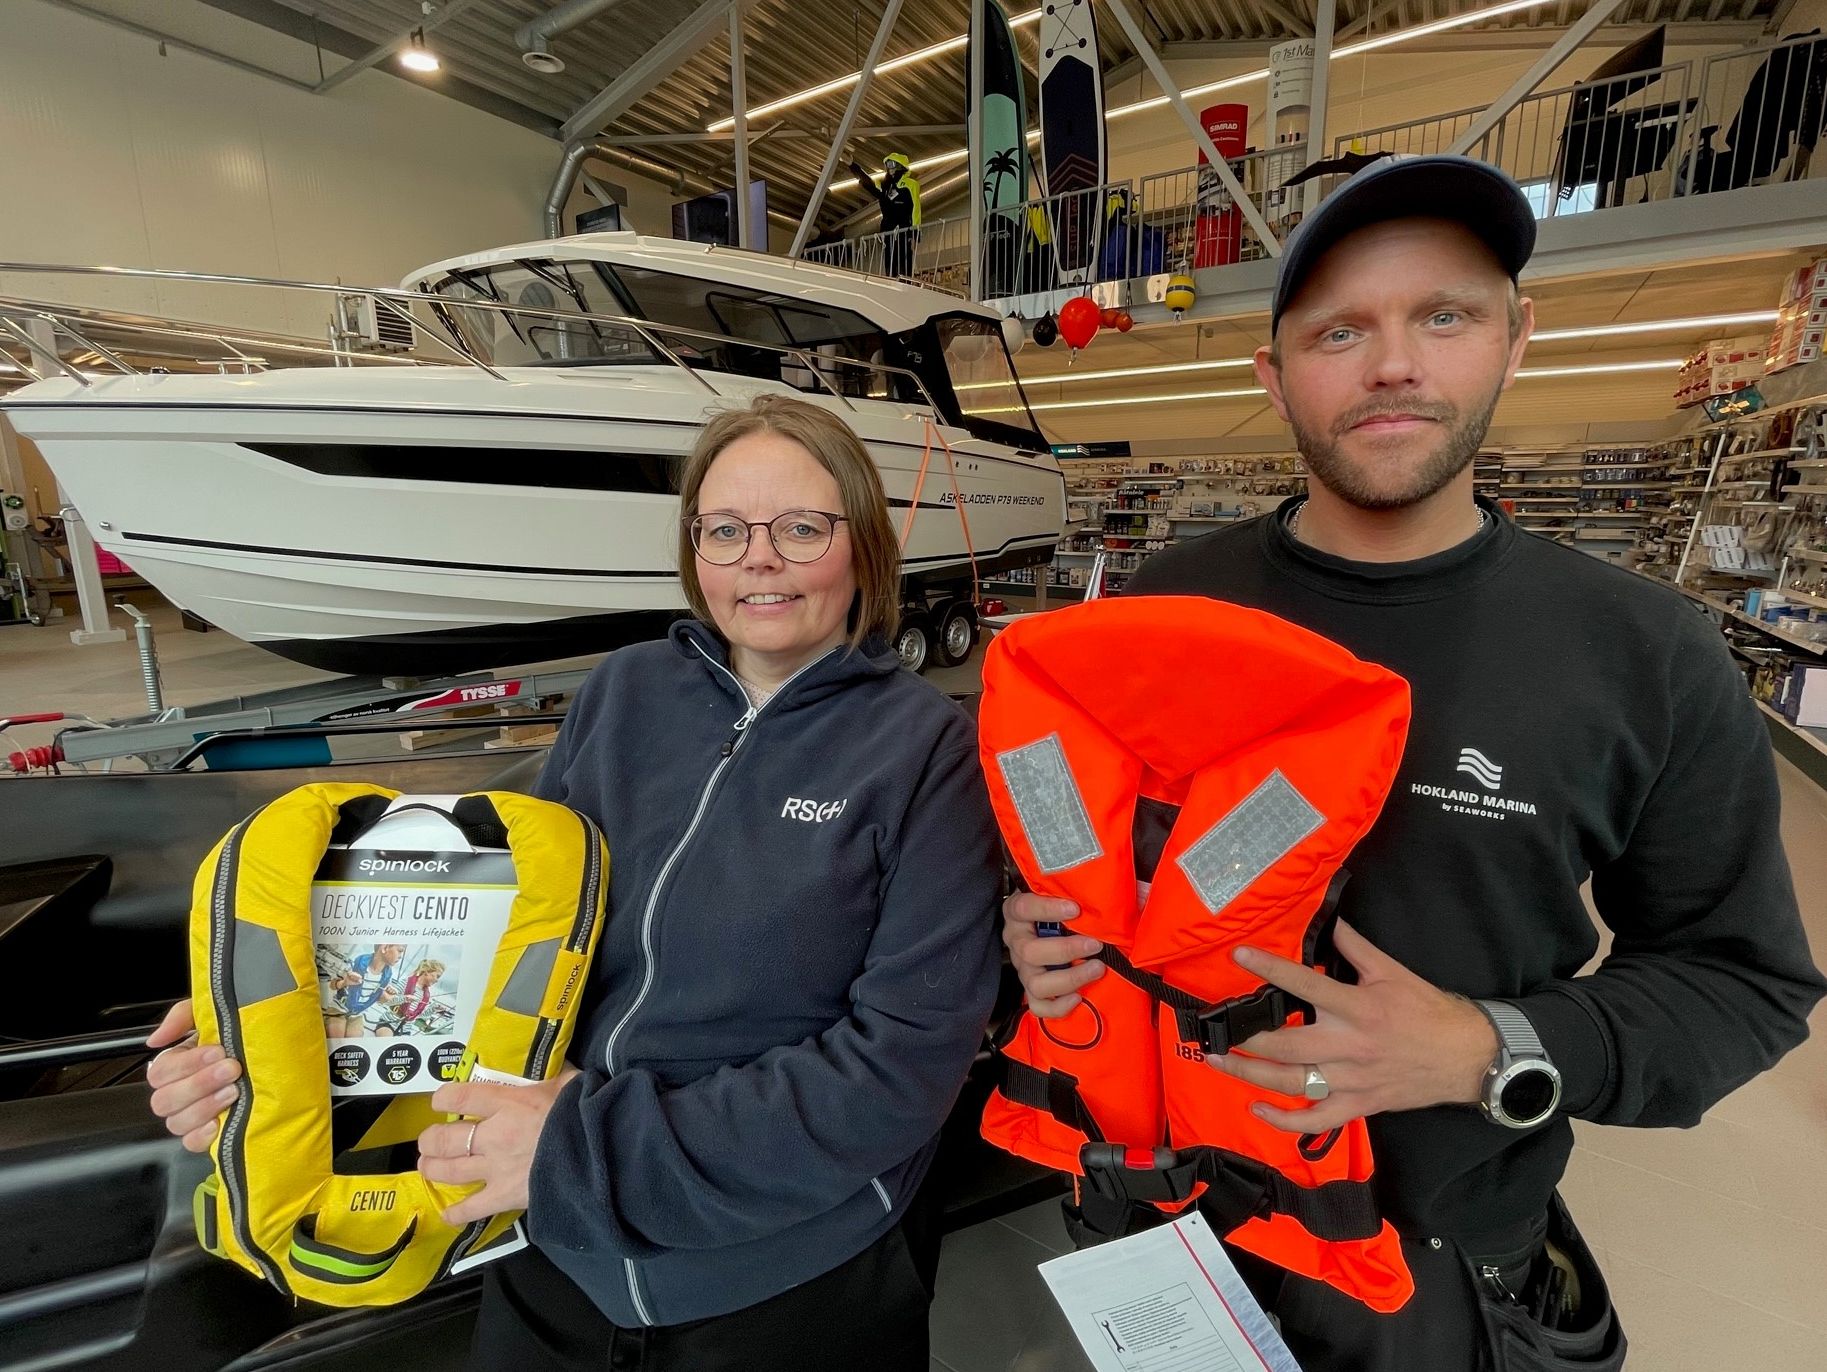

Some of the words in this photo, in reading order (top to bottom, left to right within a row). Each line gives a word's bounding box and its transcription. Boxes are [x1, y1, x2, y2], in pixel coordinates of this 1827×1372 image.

[1210, 123, 1238, 132] SIMRAD
[940, 493, 995, 505] ASKELADDEN
[1013, 496, 1045, 506] WEEKEND
[460, 684, 506, 701] TYSSE
[1411, 783, 1479, 804] HOKLAND
[1482, 795, 1537, 816] MARINA
[1441, 802, 1452, 812] by
[1453, 804, 1505, 821] SEAWORKS
[359, 859, 451, 876] spinlock
[322, 894, 408, 920] DECKVEST
[413, 896, 470, 921] CENTO
[319, 926, 346, 936] 100N
[349, 926, 379, 936] Junior
[383, 927, 418, 936] Harness
[422, 927, 465, 939] Lifejacket
[557, 964, 582, 1011] spinlock
[347, 1051, 365, 1059] SAFETY
[350, 1190, 396, 1212] CENTO
